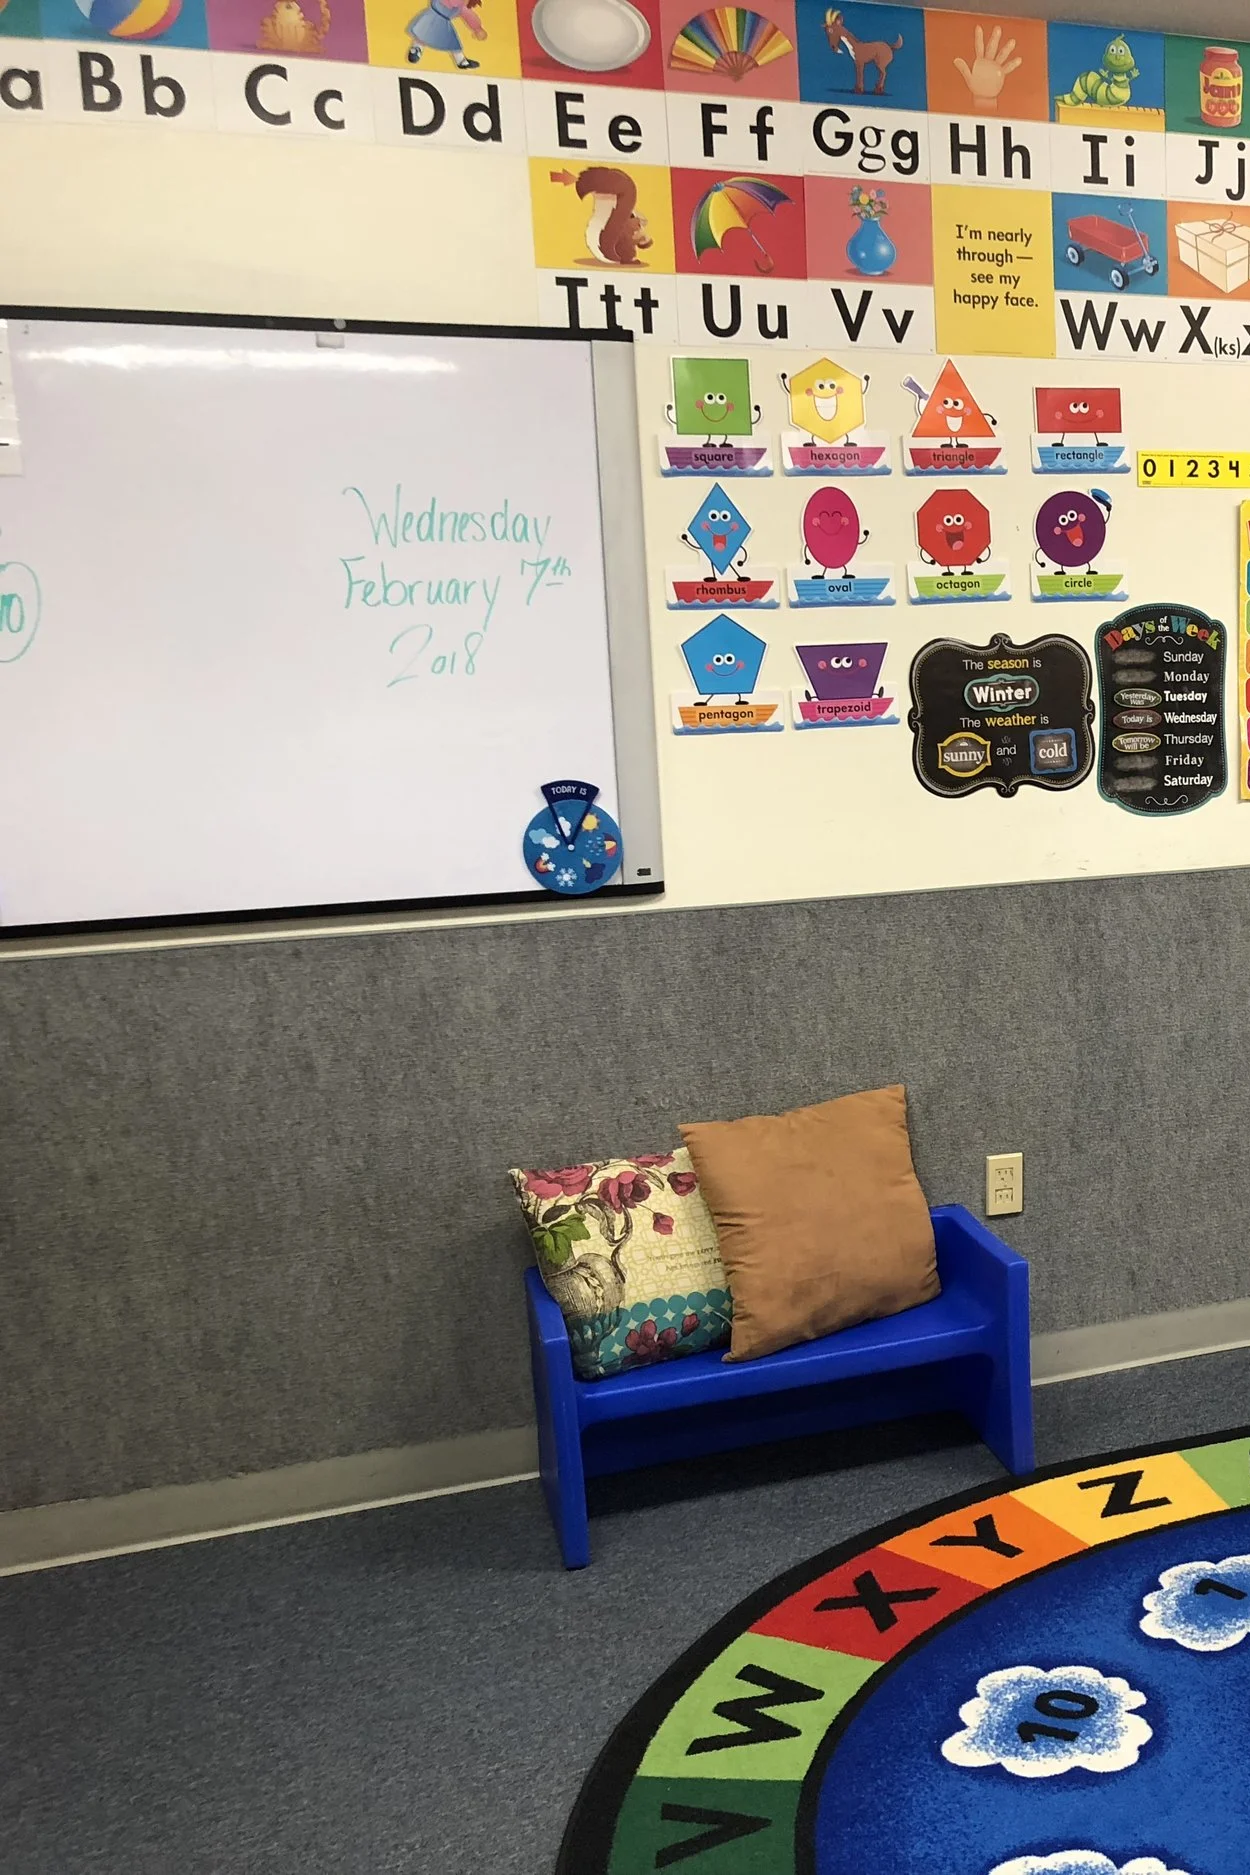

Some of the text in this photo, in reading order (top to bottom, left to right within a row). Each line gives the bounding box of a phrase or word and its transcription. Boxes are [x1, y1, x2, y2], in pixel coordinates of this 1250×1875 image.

[955, 224, 1032, 247] I'm nearly
[957, 246, 1013, 267] through
[970, 273, 1020, 289] see my
[953, 289, 1038, 309] happy face.
[694, 450, 733, 465] square
[810, 449, 860, 464] hexagon
[932, 450, 975, 465] triangle
[1054, 448, 1104, 463] rectangle
[1143, 459, 1156, 477] 0
[1169, 459, 1174, 477] 1
[1186, 459, 1199, 478] 2
[1208, 460, 1219, 478] 3
[1229, 460, 1239, 478] 4
[341, 483, 553, 560] Wednesday
[696, 583, 746, 597] rhombus
[827, 582, 852, 593] oval
[936, 579, 980, 592] octagon
[1064, 578, 1092, 589] circle
[340, 556, 502, 630] February
[1104, 620, 1156, 650] Days
[1158, 624, 1169, 632] the
[1170, 615, 1221, 650] Week
[387, 623, 485, 688] 2018
[1163, 651, 1203, 664] Sunday
[963, 657, 1041, 671] The season is
[1163, 671, 1210, 683] Monday
[972, 686, 1032, 704] Winter
[1163, 690, 1208, 703] Tuesday
[698, 708, 754, 722] pentagon
[817, 701, 872, 716] trapezoid
[960, 714, 1049, 728] The weather is
[1122, 714, 1152, 723] Today is
[1163, 712, 1217, 725] Wednesday
[1118, 737, 1155, 746] Tomorrow
[1164, 733, 1214, 746] Thursday
[943, 749, 985, 765] sunny
[996, 744, 1016, 756] and
[1039, 743, 1068, 759] cold
[1166, 755, 1204, 767] Friday
[1163, 774, 1213, 787] Saturday
[551, 785, 587, 795] TODAY IS
[813, 1571, 940, 1633] X
[685, 1663, 826, 1758] W
[1015, 1688, 1101, 1748] 10
